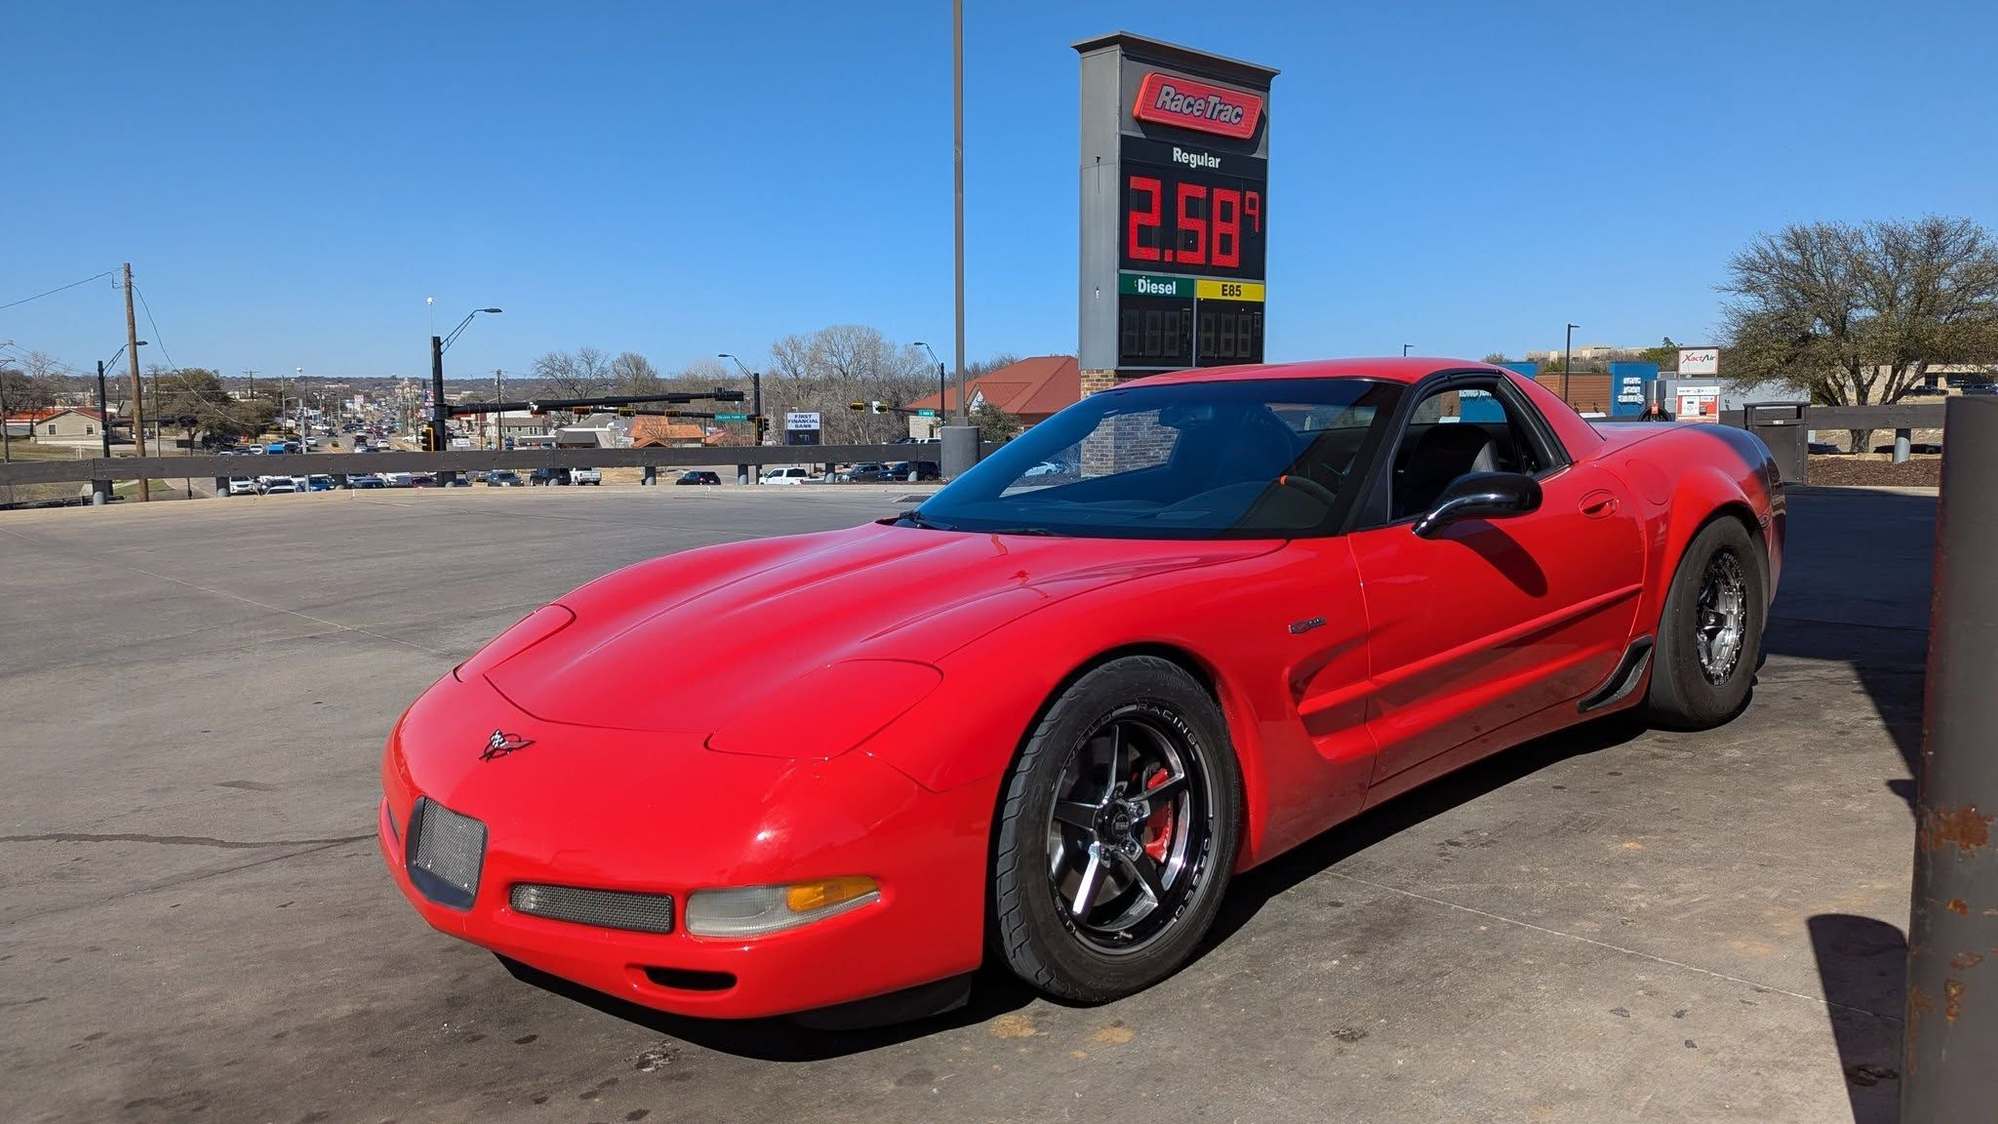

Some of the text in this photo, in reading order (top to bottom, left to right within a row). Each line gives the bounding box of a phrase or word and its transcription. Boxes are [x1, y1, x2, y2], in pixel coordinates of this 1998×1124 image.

[1155, 84, 1244, 124] RaceTrac
[1172, 147, 1221, 169] Regular
[1137, 277, 1176, 295] Diesel
[1221, 283, 1242, 298] E85
[1137, 703, 1197, 745] RACING
